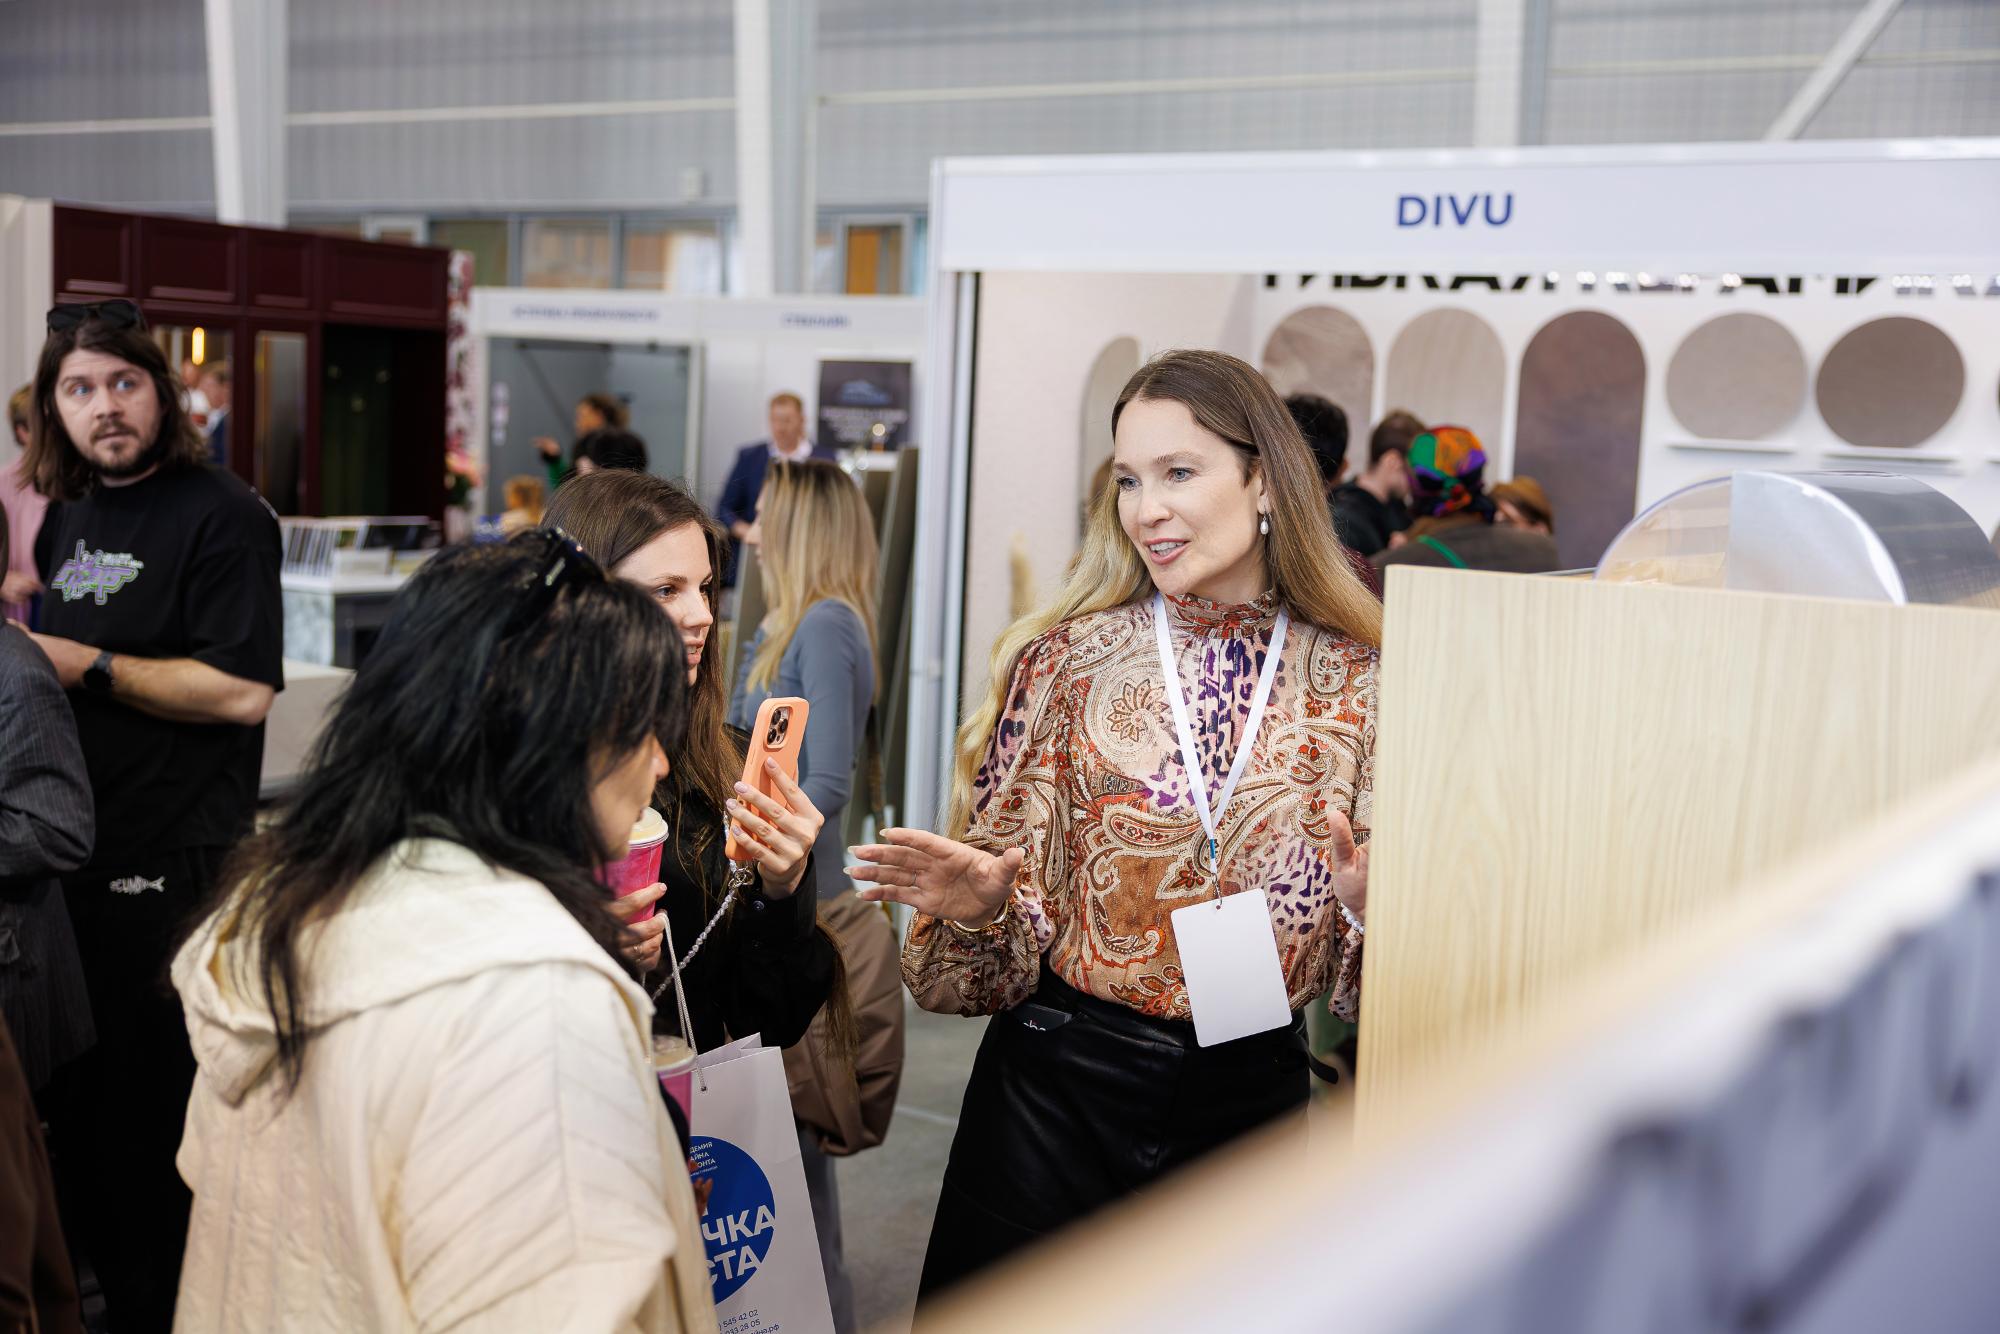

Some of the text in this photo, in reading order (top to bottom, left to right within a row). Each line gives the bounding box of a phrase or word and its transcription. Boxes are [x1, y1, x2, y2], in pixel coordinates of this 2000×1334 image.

[1397, 194, 1513, 227] DIVU
[738, 1312, 748, 1321] 42
[748, 1309, 759, 1318] 02
[750, 1318, 761, 1328] 05
